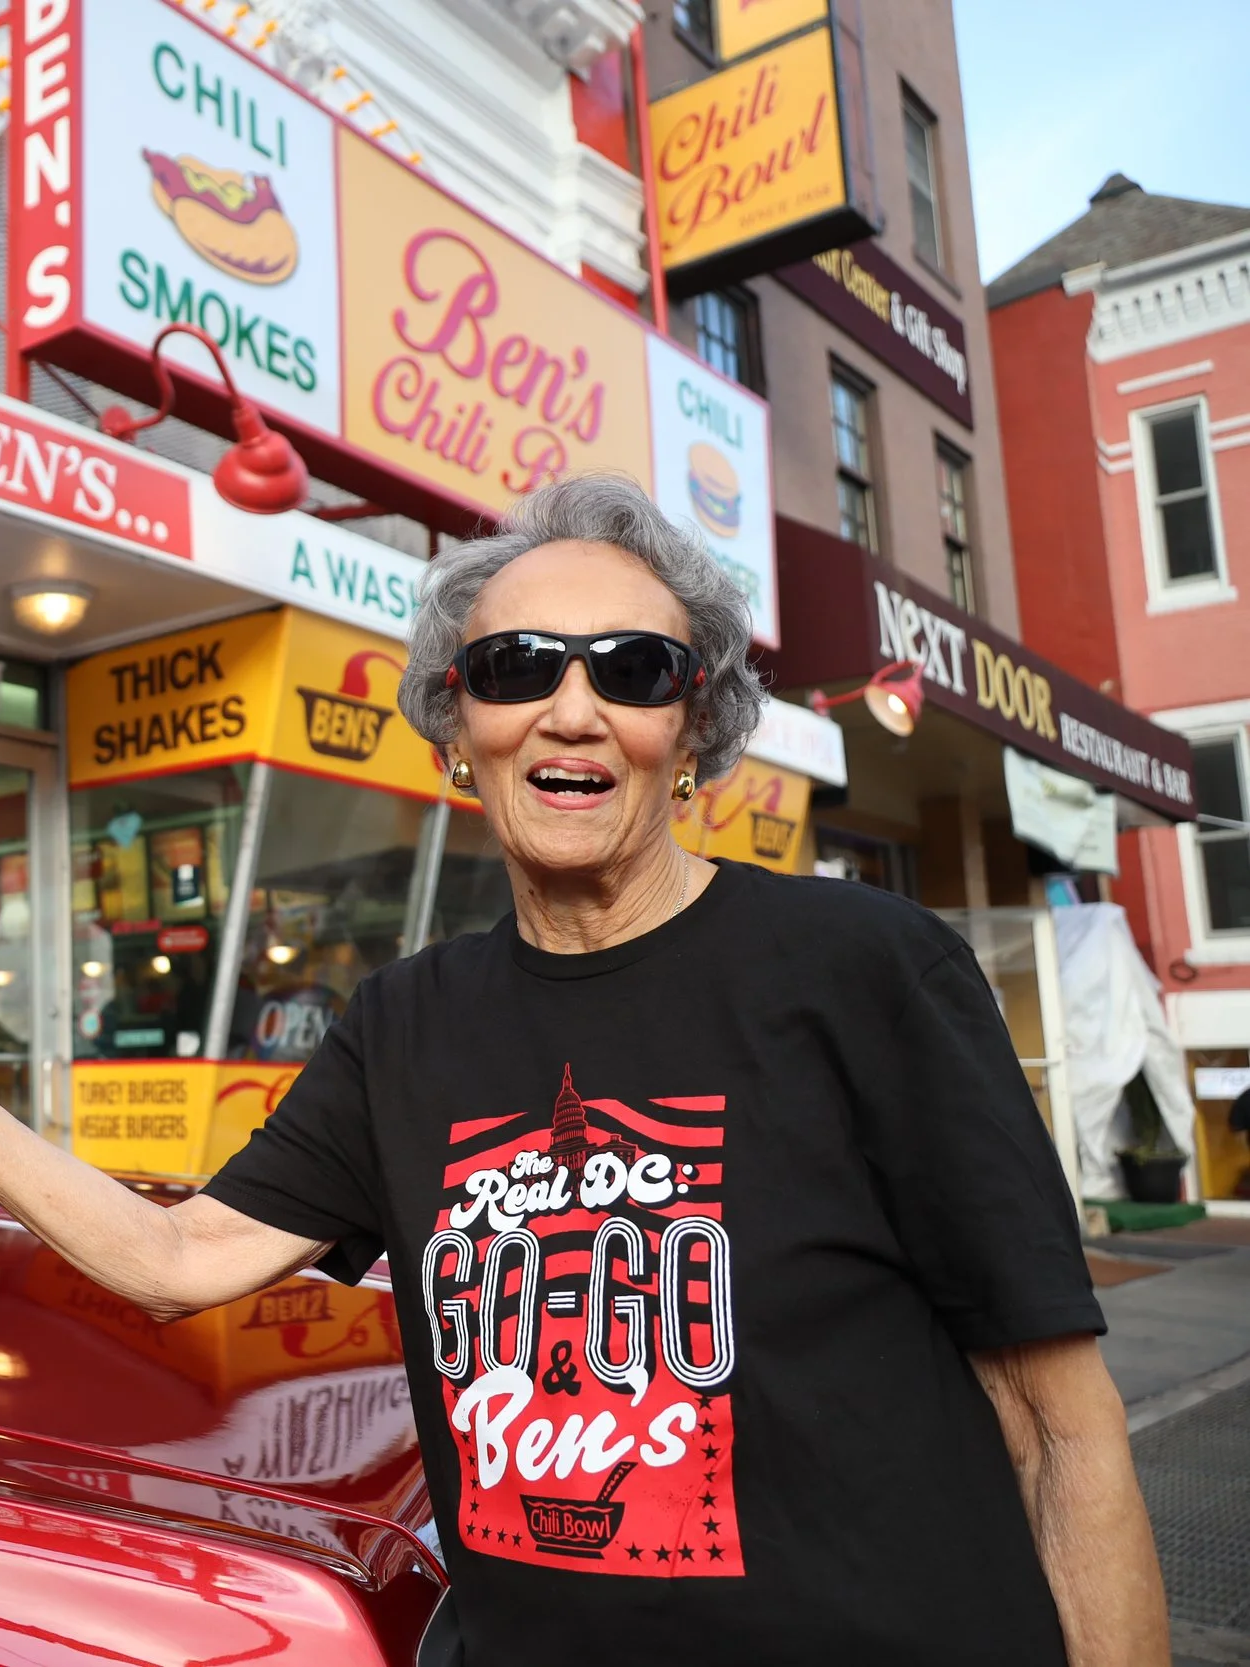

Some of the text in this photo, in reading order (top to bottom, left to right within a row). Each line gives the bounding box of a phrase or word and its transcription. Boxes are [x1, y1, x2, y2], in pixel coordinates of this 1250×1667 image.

[153, 42, 287, 168] CHILI
[659, 65, 779, 182] Chili
[661, 91, 829, 252] Bowl
[118, 248, 318, 393] SMOKES
[392, 227, 606, 445] Ben's
[371, 353, 495, 475] Chili
[677, 379, 743, 449] CHILI
[290, 539, 315, 590] A
[110, 639, 225, 704] THICK
[93, 694, 247, 766] SHAKES
[971, 637, 1058, 742] DOOR
[1059, 711, 1150, 790] RESTAURANT
[1149, 757, 1164, 794] &
[1162, 761, 1193, 805] BAR
[126, 1114, 188, 1141] BURGERS
[127, 1079, 188, 1105] BURGERS
[449, 1151, 696, 1233] Real DC:
[510, 1150, 555, 1180] The
[421, 1215, 737, 1388] GO-GO
[542, 1339, 584, 1397] &
[451, 1365, 699, 1490] Ben's
[530, 1508, 612, 1540] Chili Bowl
